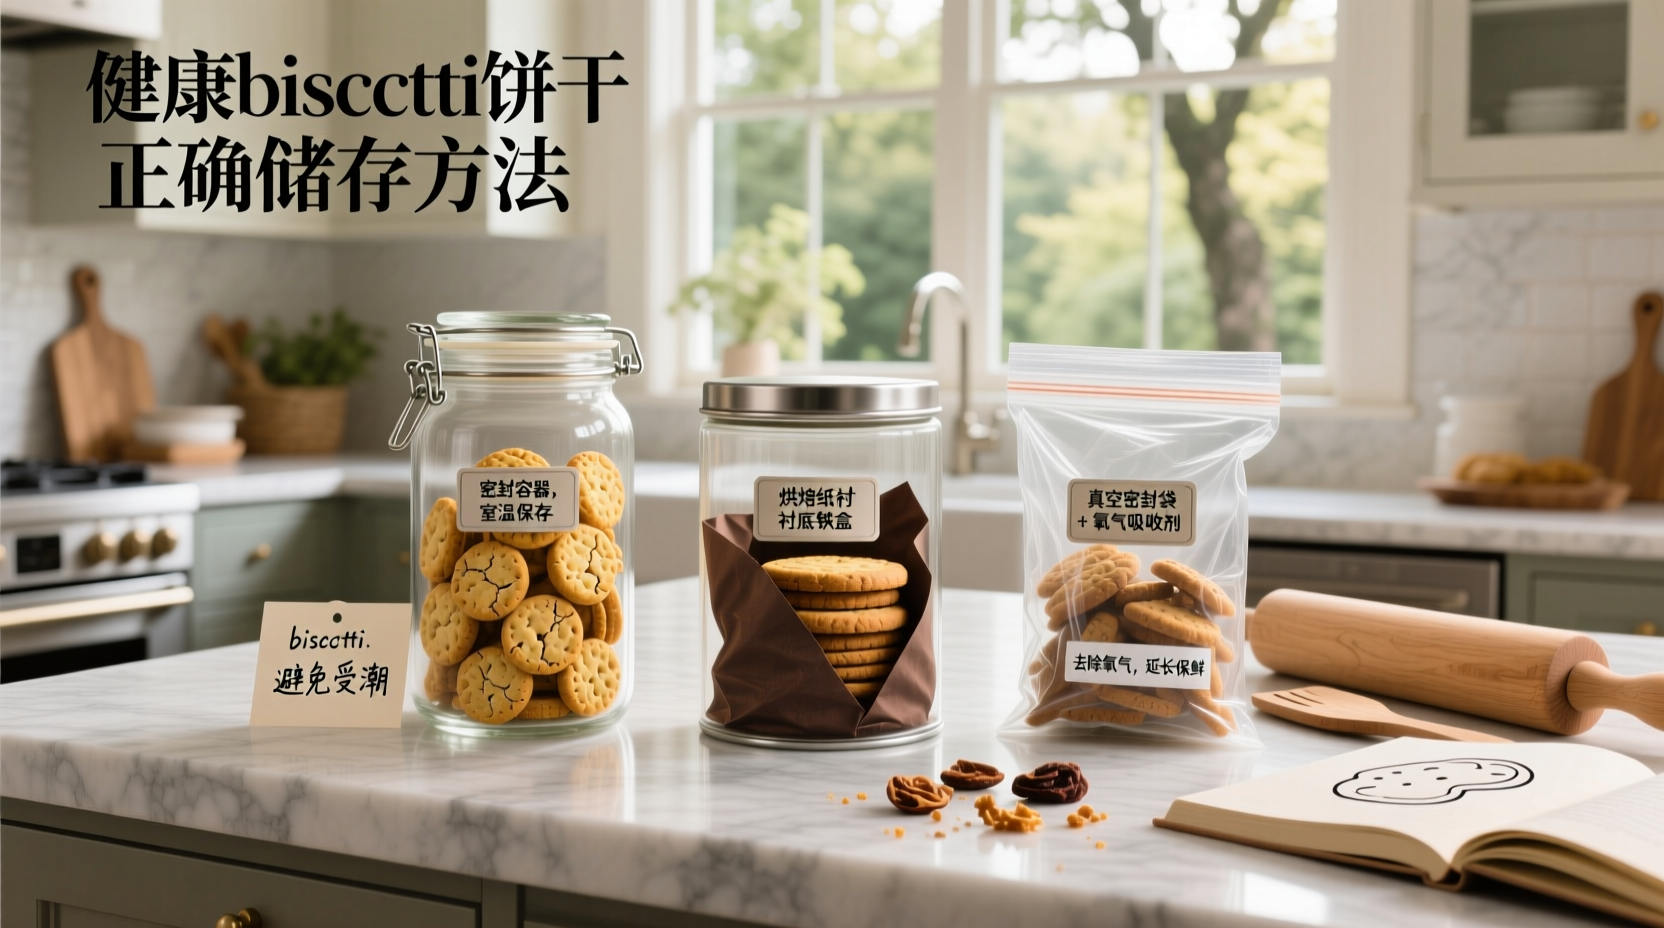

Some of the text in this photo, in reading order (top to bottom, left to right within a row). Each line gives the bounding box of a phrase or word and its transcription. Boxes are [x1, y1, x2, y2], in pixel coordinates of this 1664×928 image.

[1087, 488, 1177, 510] 真空密封袋
[479, 502, 554, 522] 室温保存
[1077, 512, 1181, 533] + 氧气吸收剂
[272, 659, 389, 699] 避免受潮
